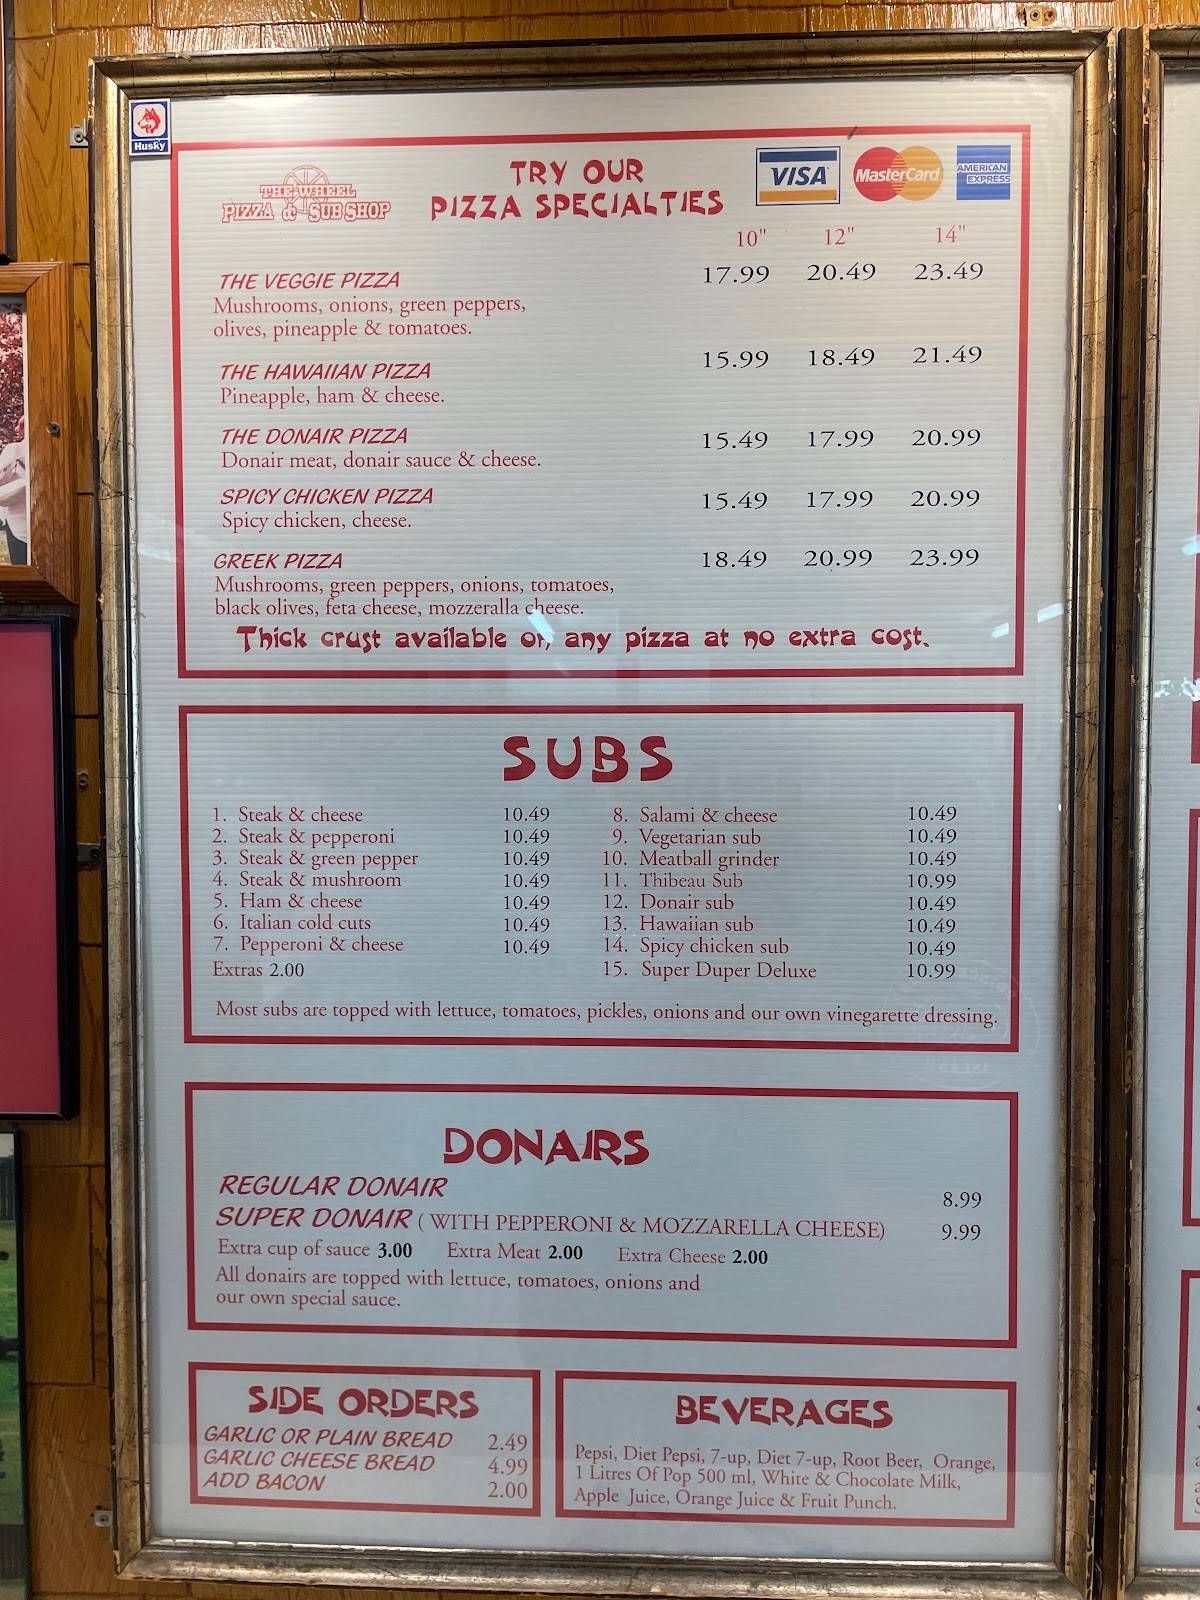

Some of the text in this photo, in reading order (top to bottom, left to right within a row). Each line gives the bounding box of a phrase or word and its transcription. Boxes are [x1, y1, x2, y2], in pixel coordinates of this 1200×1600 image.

[134, 140, 166, 152] Husky
[510, 159, 643, 186] TRY OUR
[770, 166, 828, 186] VISA
[855, 168, 941, 183] MasterCard
[957, 163, 1007, 173] AMERICAN
[967, 174, 1011, 184] EXPRESS
[259, 183, 357, 199] THE WHEEL
[222, 201, 391, 223] PIZZA & SUB SHOP
[432, 190, 723, 221] PIZZA SPECIALTIES
[704, 266, 769, 284] 17.99
[807, 262, 875, 281] 20.49
[914, 261, 983, 280] 23.49
[221, 272, 399, 289] THE VEGGIE PIZZA
[214, 296, 525, 317] Mushrooms, onions, green peppers,
[214, 318, 471, 342] olives, pineapple & tomatoes.
[704, 351, 768, 369] 15.99
[809, 348, 874, 366] 18.49
[913, 345, 982, 363] 21.49
[221, 362, 430, 380] THE HAWAIIAN PIZZA
[221, 385, 444, 409] Pineapple, ham & cheese.
[222, 428, 407, 444] THE DONAIR PIZZA
[703, 431, 768, 450] 15.49
[808, 430, 873, 448] 17.99
[912, 429, 980, 446] 20.99
[222, 449, 540, 469] Donair meat, donair sauce & cheese.
[221, 488, 433, 504] SPICY CHICKEN PIZZA
[703, 491, 767, 510] 15.49
[808, 491, 873, 508] 17.99
[910, 490, 979, 507] 20.99
[223, 510, 411, 533] Spicy chicken, cheese.
[214, 553, 342, 569] GREEK PIZZA
[702, 550, 767, 568] 18.49
[804, 550, 872, 567] 20.99
[910, 549, 979, 566] 23.99
[236, 626, 307, 653] Thick
[321, 630, 380, 653] crust
[395, 627, 507, 648] available
[565, 632, 611, 654] any
[626, 626, 690, 653] pizza
[704, 628, 729, 647] at
[744, 630, 774, 650] no
[789, 627, 856, 647] extra
[871, 626, 929, 651] cost.
[504, 736, 672, 783] SUBS
[214, 806, 363, 821] 1. Steak & cheese
[504, 806, 549, 822] 10.49
[613, 828, 760, 849] 9. Vegetarian sub
[908, 828, 956, 844] 10.49
[213, 849, 418, 870] 3. Steak & green pepper
[504, 851, 549, 866] 10.49
[604, 873, 742, 887] 11. Thibeau Sub
[908, 874, 956, 889] 10.99
[214, 913, 371, 929] 6. Italian cold cuts
[504, 917, 549, 933] 10.49
[213, 961, 304, 977] Extras 2.00
[604, 961, 816, 982] 15. Super Duper Deluxe
[908, 964, 955, 978] 10.99
[443, 1128, 649, 1166] DONAIRS
[219, 1175, 448, 1197] REGULAR DONAIR
[943, 1192, 981, 1208] 8.99
[216, 1207, 413, 1228] SUPER DONAIR
[942, 1224, 980, 1240] 9.99
[219, 1239, 412, 1260] Extra cup of sauce 3.00
[447, 1242, 583, 1259] Extra Meat 2.00
[619, 1248, 768, 1264] Extra Cheese 2.00
[249, 1386, 479, 1418] SIDE ORDERS
[676, 1395, 893, 1428] BEVERAGES
[205, 1426, 453, 1448] GARLIC OR PLAIN BREAD
[488, 1434, 527, 1451] 2.49
[204, 1449, 435, 1471] GARLIC CHEESE BREAD
[489, 1456, 527, 1475] 4.99
[203, 1472, 325, 1491] ADD BACON
[488, 1482, 527, 1498] 2.00
[575, 1487, 896, 1510] Apple Juice, Orange Juice & Fruit Punch.
